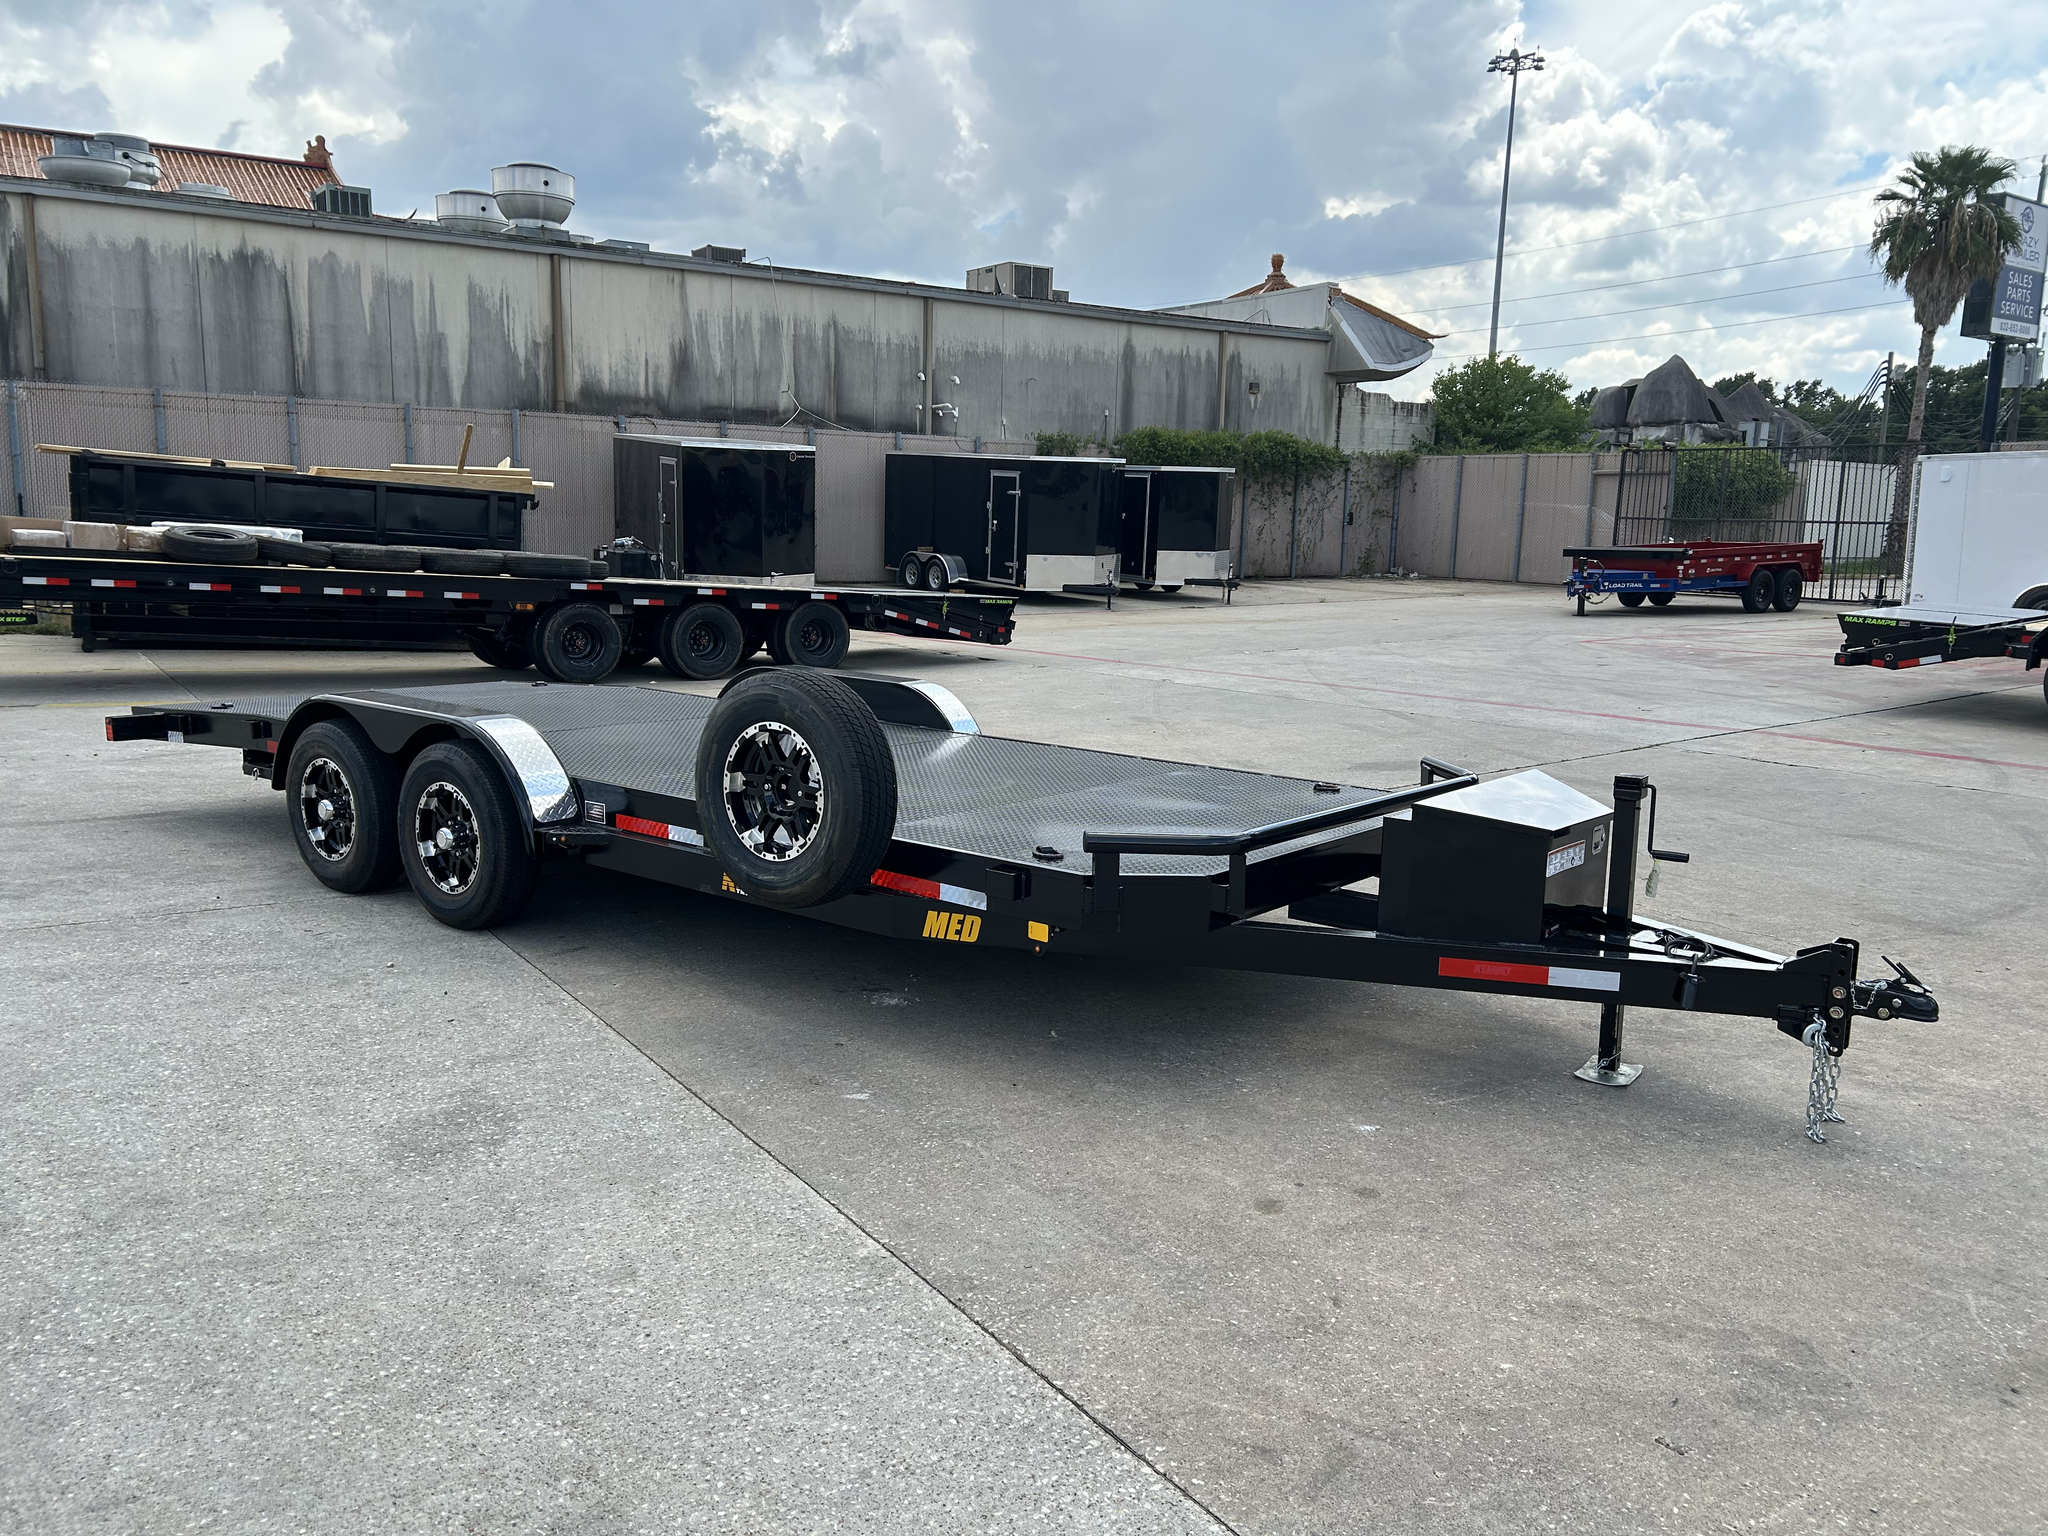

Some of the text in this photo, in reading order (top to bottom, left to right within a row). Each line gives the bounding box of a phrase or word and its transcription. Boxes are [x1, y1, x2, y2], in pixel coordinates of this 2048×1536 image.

[2008, 271, 2033, 288] SALES
[2006, 286, 2031, 302] PARTS
[2000, 300, 2034, 318] SERVICE
[1844, 615, 1864, 623] MAX
[1864, 618, 1897, 626] RAMPS
[922, 910, 982, 942] MED
